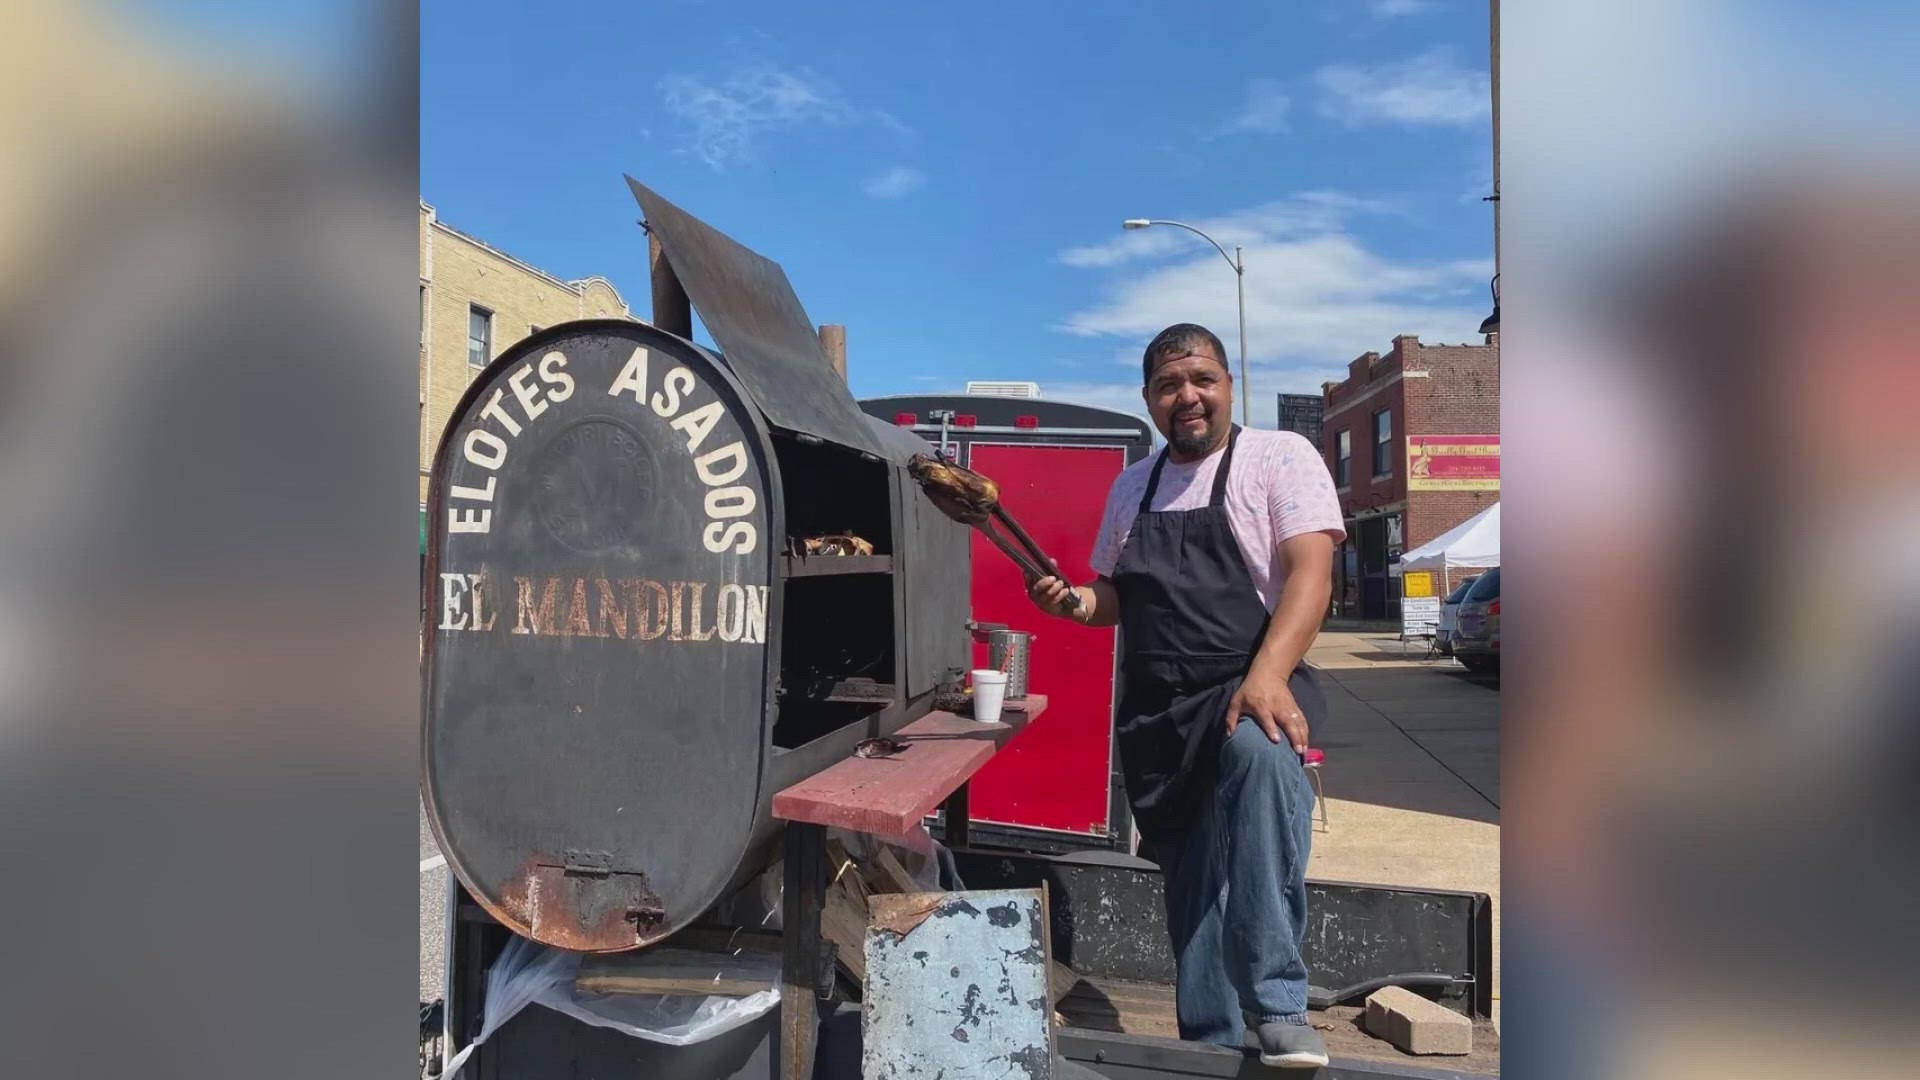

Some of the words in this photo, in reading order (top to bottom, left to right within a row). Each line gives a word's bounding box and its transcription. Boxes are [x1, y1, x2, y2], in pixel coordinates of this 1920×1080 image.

[448, 351, 575, 533] ELOTES
[608, 347, 757, 555] ASADOS
[438, 572, 497, 632] EL
[511, 575, 771, 644] MANDILON
